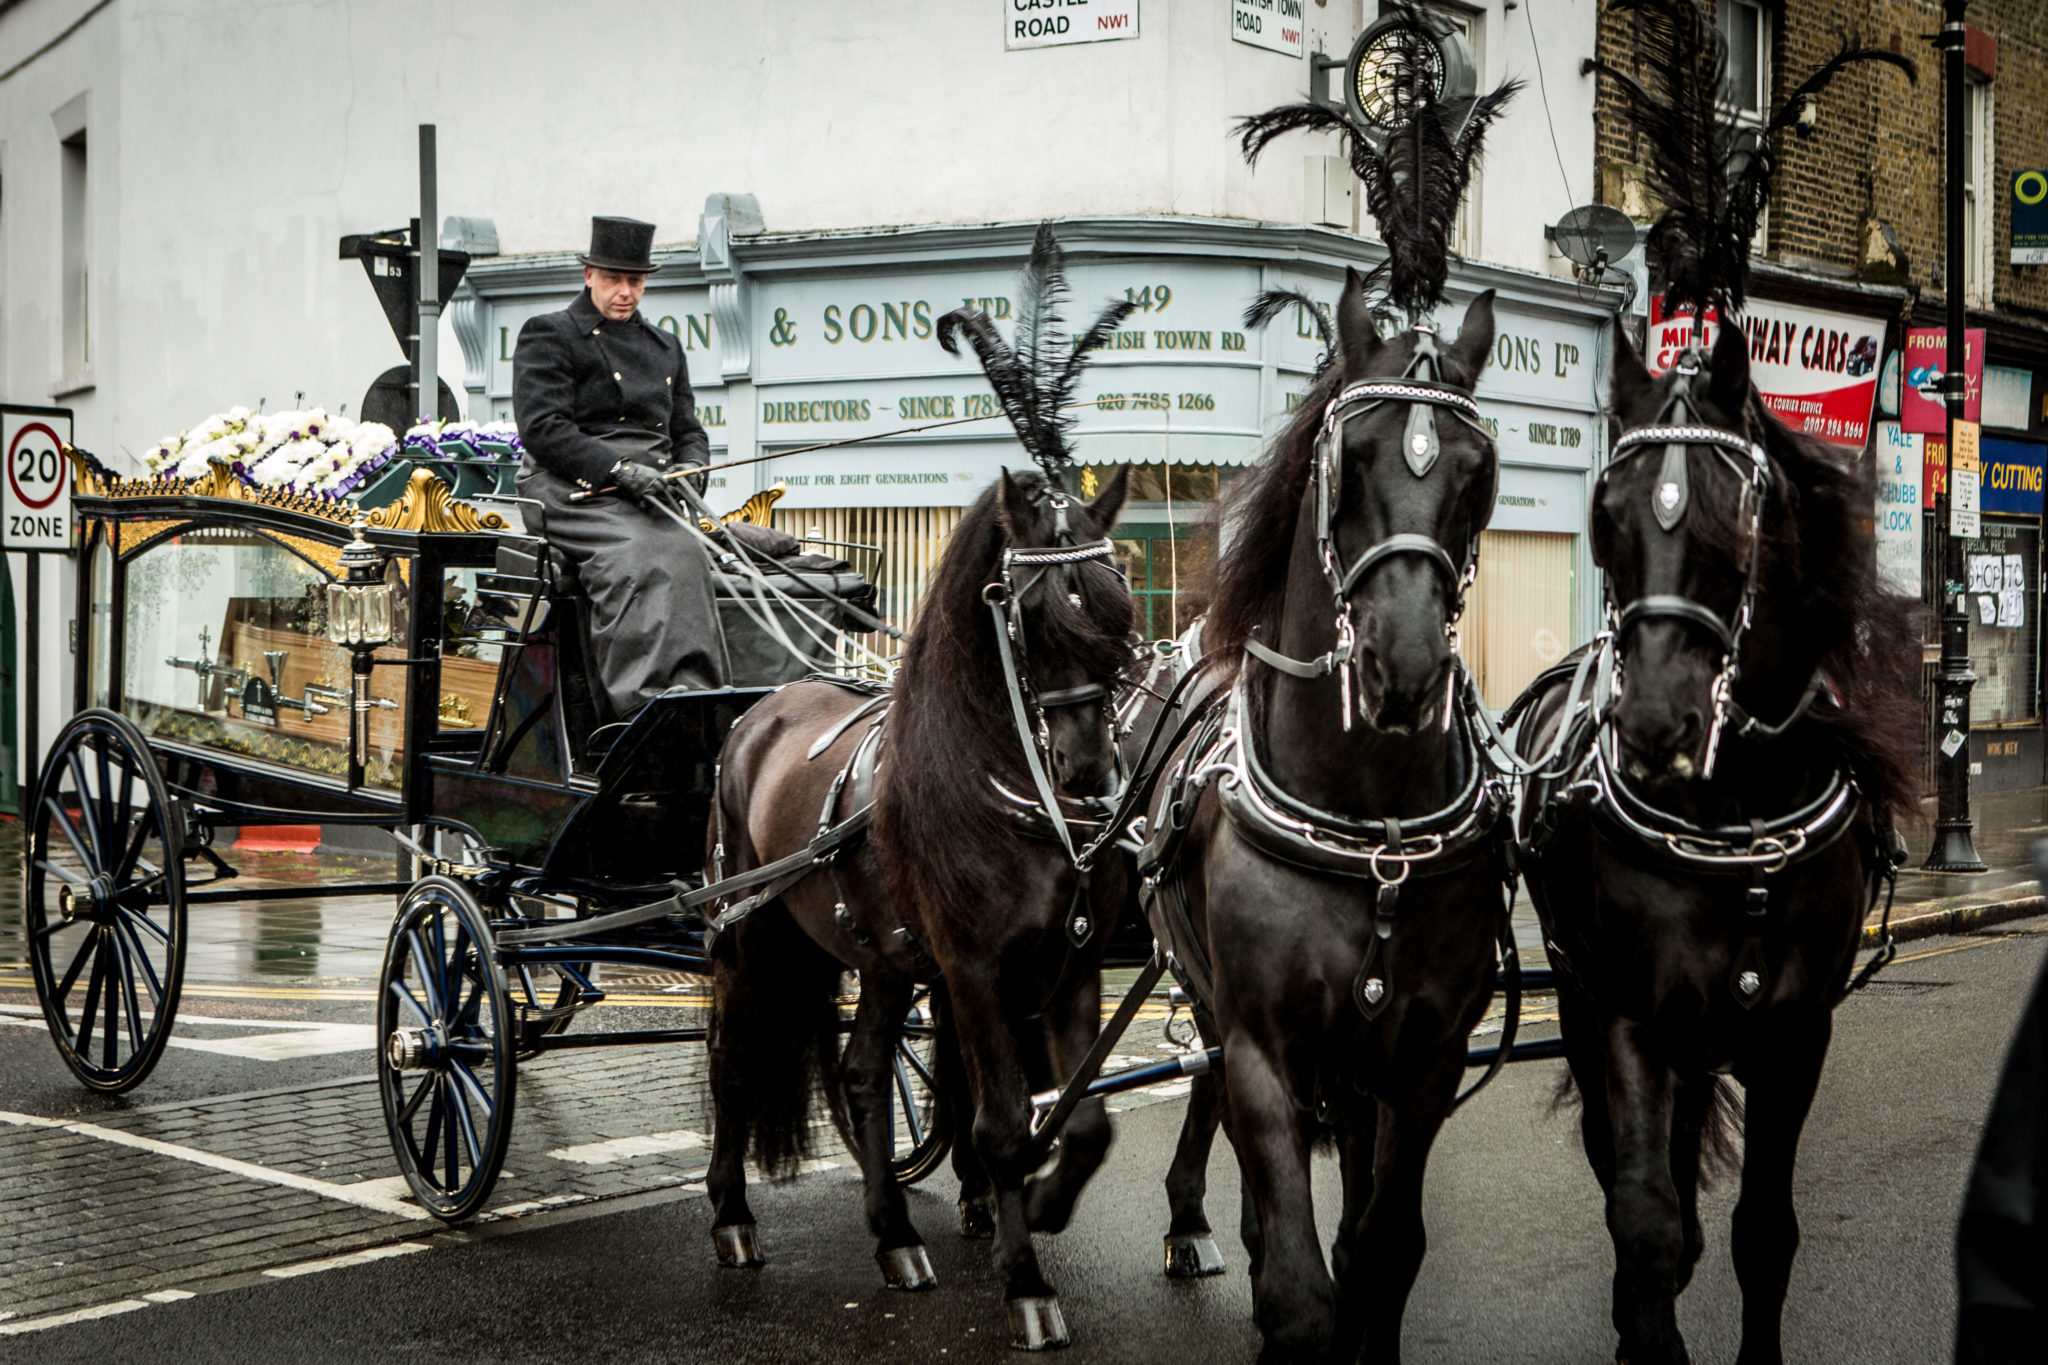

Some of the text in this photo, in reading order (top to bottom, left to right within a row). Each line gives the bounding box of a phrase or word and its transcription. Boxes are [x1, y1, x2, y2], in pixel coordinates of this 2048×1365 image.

[1014, 0, 1088, 11] CAS
[1277, 0, 1302, 20] TOWN
[1015, 16, 1070, 38] ROAD
[1097, 13, 1128, 30] NW1
[1236, 10, 1262, 34] ROAD
[1282, 27, 1300, 45] NW1
[389, 266, 402, 277] 53
[1123, 284, 1173, 314] 149
[769, 307, 797, 348] &
[823, 300, 933, 344] SONS
[1072, 330, 1147, 350] KTISH
[1154, 330, 1213, 351] TOWN
[1800, 325, 1850, 374] CARS
[1908, 335, 1947, 350] FROM
[763, 394, 1005, 424] DIRECTORS SINCE 1789
[1096, 392, 1215, 412] 020 7485 1266
[1773, 397, 1800, 412] COURIER
[1799, 400, 1824, 415] SERVICE
[1528, 422, 1581, 449] SINCE 1789
[1803, 416, 1864, 439] 0207 284 2666
[1887, 425, 1913, 448] YALE
[18, 448, 57, 483] 20
[1895, 455, 1903, 475] &
[1926, 442, 1947, 467] FRO
[773, 475, 811, 486] FAMILY
[814, 474, 835, 486] FOR
[840, 473, 872, 485] EIGHT
[875, 472, 949, 485] GENERATIONS
[1991, 461, 2043, 492] CUTTING
[1497, 495, 1536, 508] GENERATIONS
[1880, 482, 1916, 504] CHUBB
[10, 515, 63, 537] ZONE
[1883, 510, 1913, 533] LOCK
[2005, 563, 2024, 587] TO
